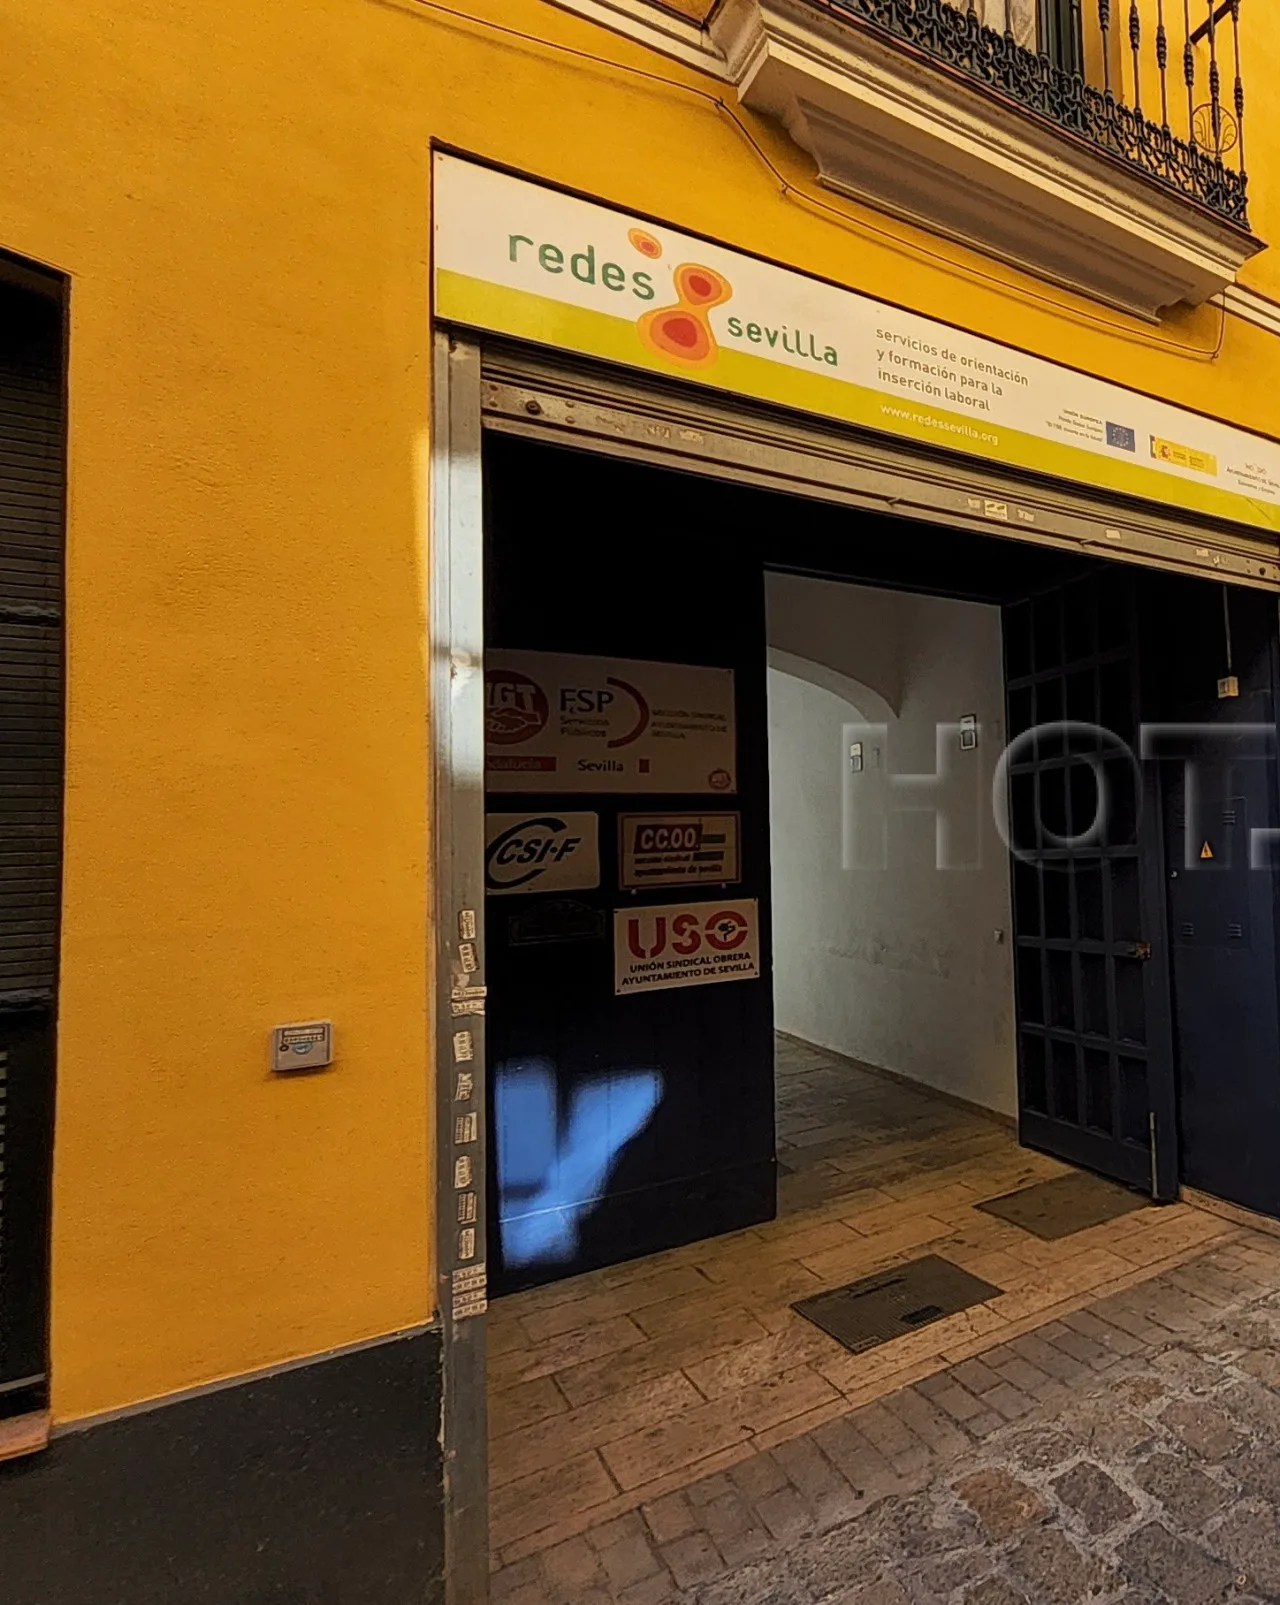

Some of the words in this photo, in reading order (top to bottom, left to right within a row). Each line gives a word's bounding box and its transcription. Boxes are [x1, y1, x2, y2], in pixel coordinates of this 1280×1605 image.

[508, 232, 655, 301] redes
[726, 315, 839, 367] sevilla
[876, 329, 938, 356] servicios
[941, 348, 957, 362] de
[960, 356, 1029, 386] orientación
[876, 349, 885, 361] y
[889, 350, 956, 382] formación
[960, 375, 988, 392] para
[991, 382, 1003, 396] la
[878, 367, 941, 397] inserción
[944, 387, 990, 411] laboral
[880, 405, 999, 446] www.redessevilla.org
[560, 688, 614, 713] FSP
[577, 758, 624, 772] Sevilla
[628, 910, 749, 959] USO
[621, 969, 702, 986] AYUNTAMIENTO
[703, 966, 716, 976] DE
[718, 962, 755, 974] SEVILLA
[630, 960, 665, 973] UNIÓN
[666, 957, 712, 969] SINDICAL
[713, 951, 751, 963] OBRERA
